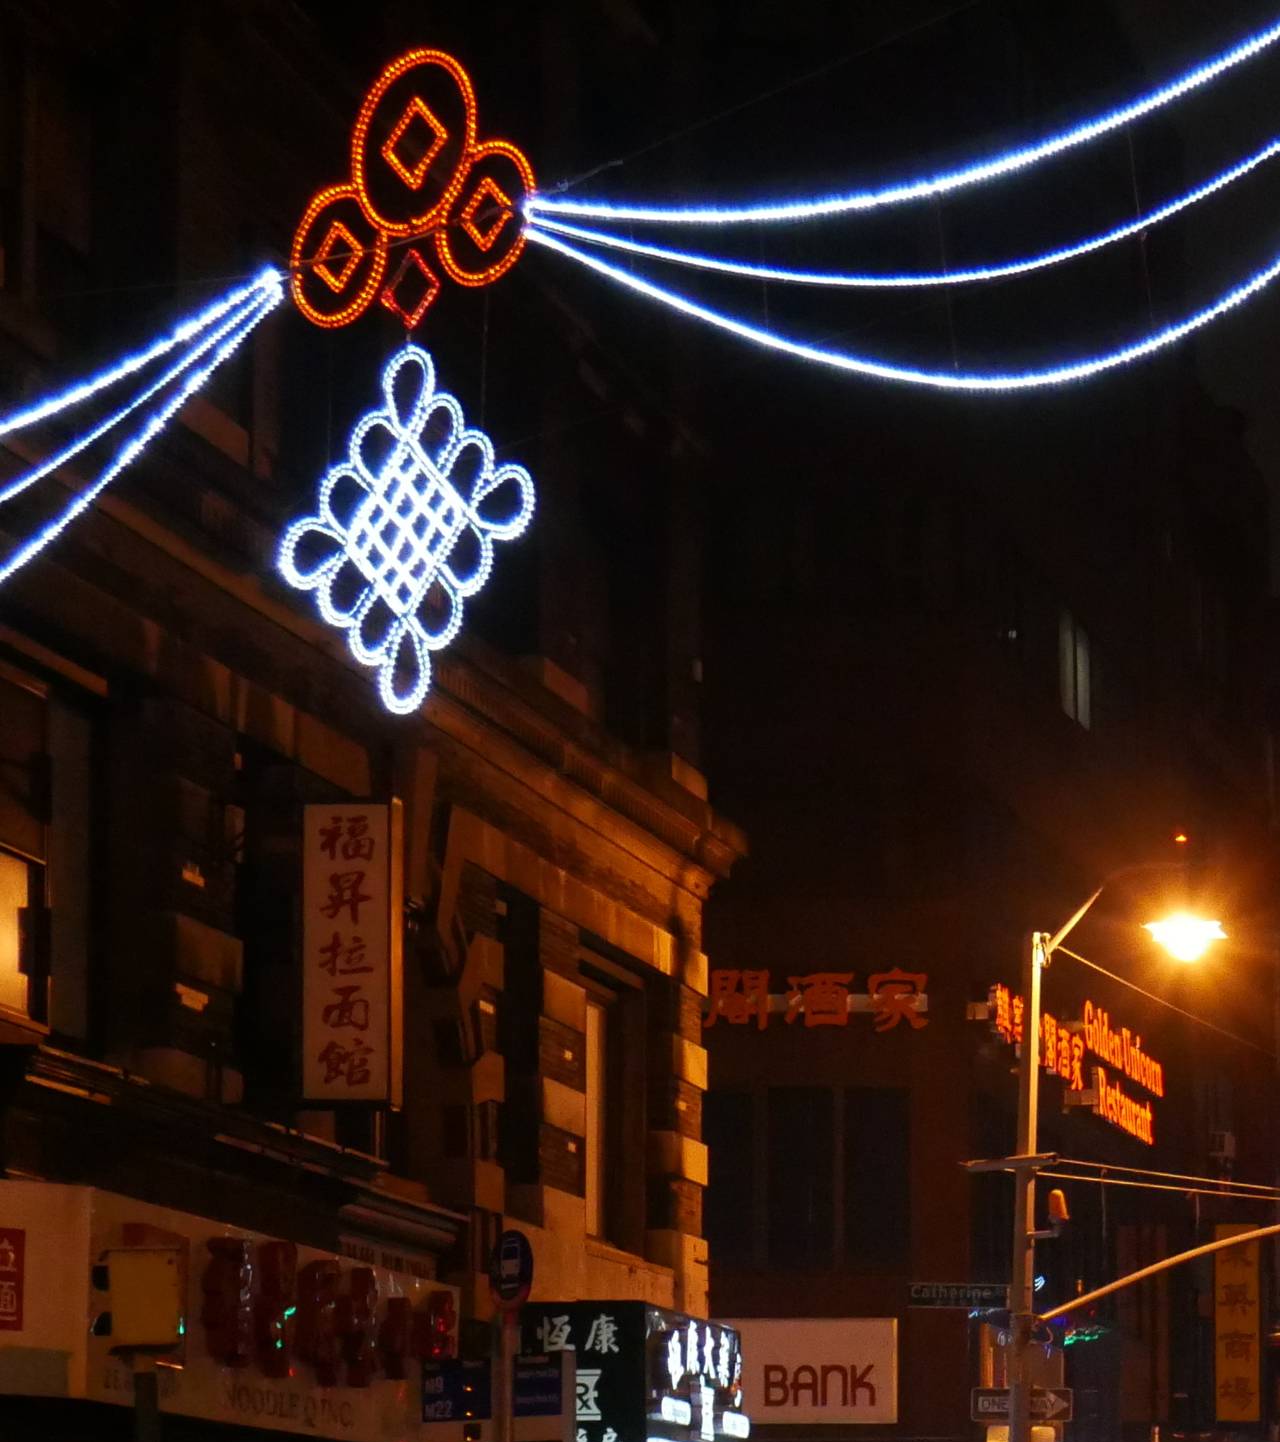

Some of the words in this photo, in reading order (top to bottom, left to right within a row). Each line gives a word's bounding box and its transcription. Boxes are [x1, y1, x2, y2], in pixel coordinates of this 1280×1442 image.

[1084, 999, 1123, 1070] Golden
[1122, 1027, 1164, 1098] Unicorn
[1097, 1066, 1154, 1145] Restaurant
[910, 1285, 992, 1299] Catherine
[763, 1364, 876, 1407] BANK
[981, 1398, 1010, 1411] ONE
